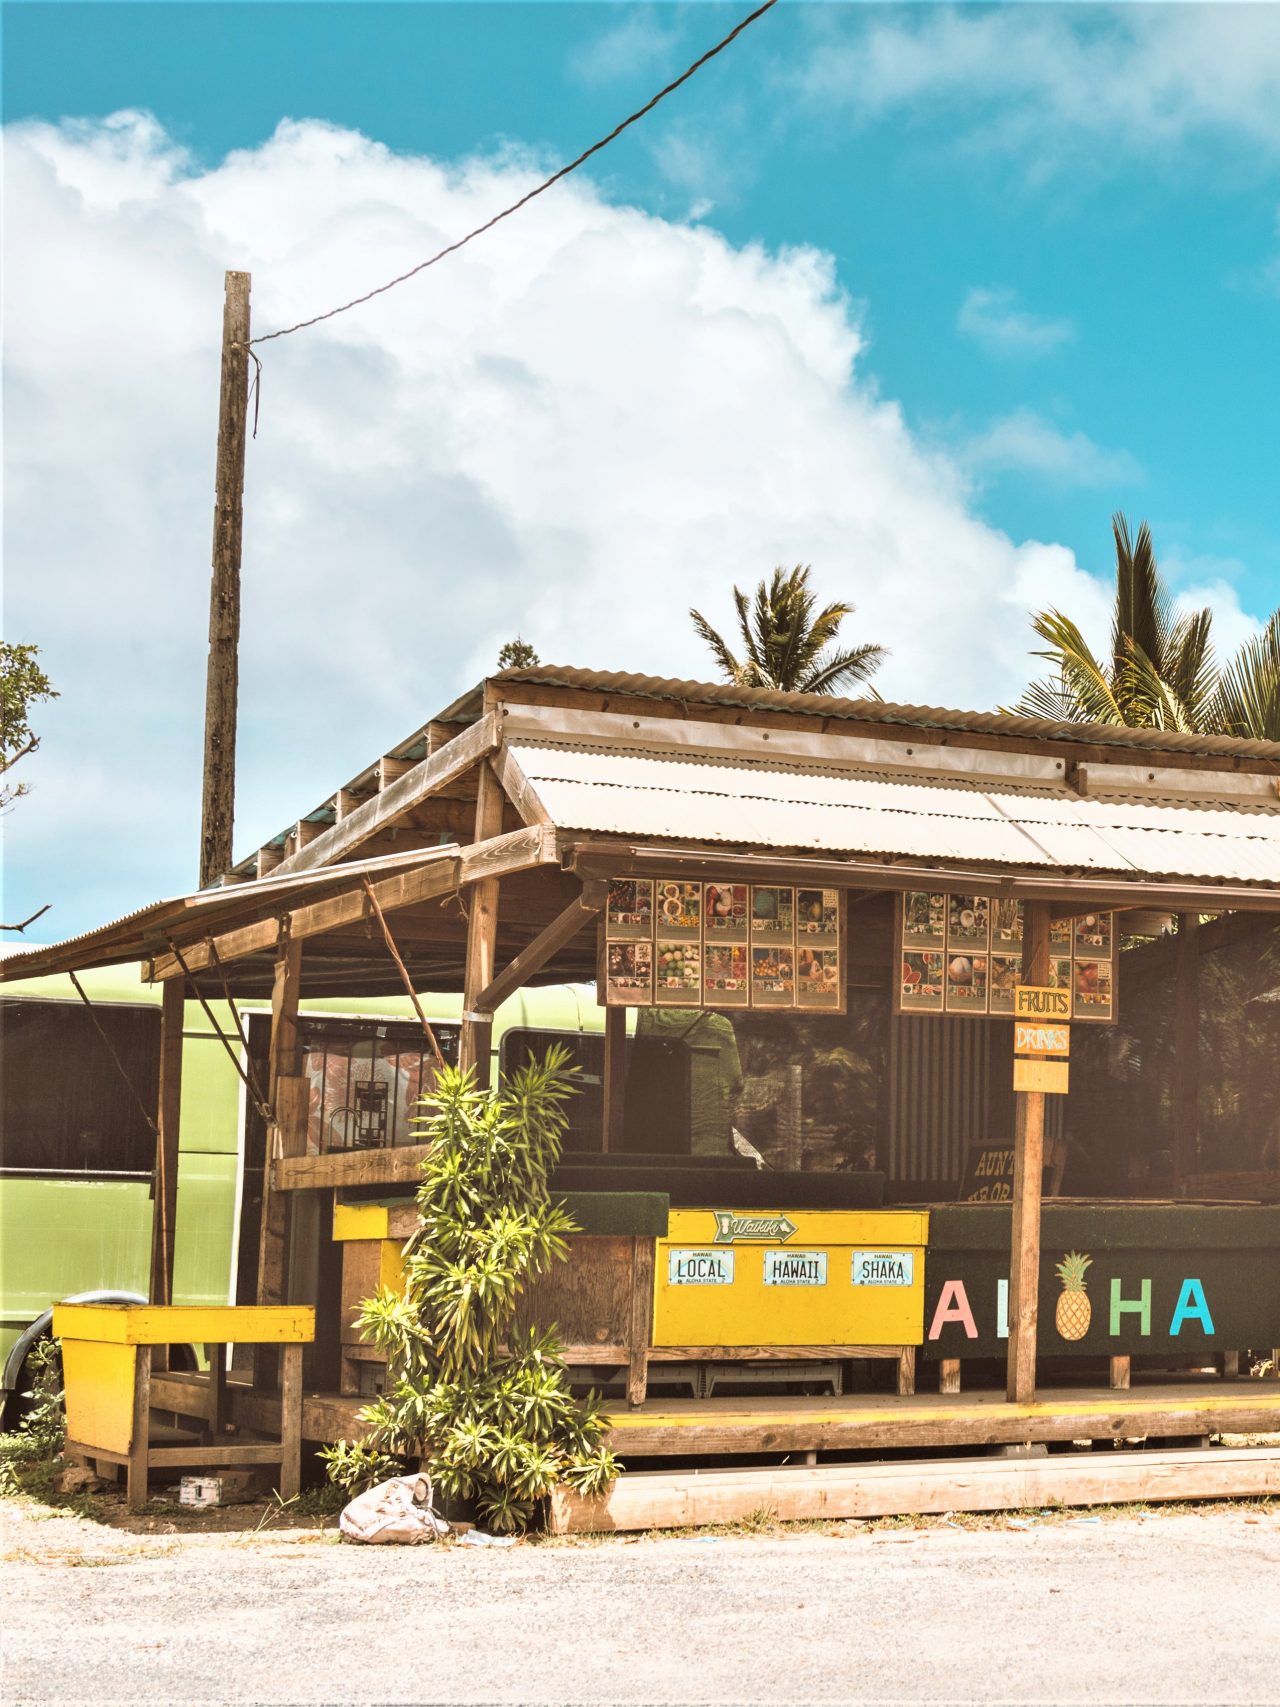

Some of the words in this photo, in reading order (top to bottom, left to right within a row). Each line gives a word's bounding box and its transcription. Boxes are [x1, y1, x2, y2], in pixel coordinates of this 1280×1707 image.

[1018, 990, 1069, 1014] FRUITS
[1017, 1027, 1068, 1050] DRINKS
[730, 1219, 780, 1236] Waikiki
[677, 1259, 726, 1278] LOCAL
[773, 1260, 819, 1279] HAWAII
[862, 1260, 904, 1279] SHAKA
